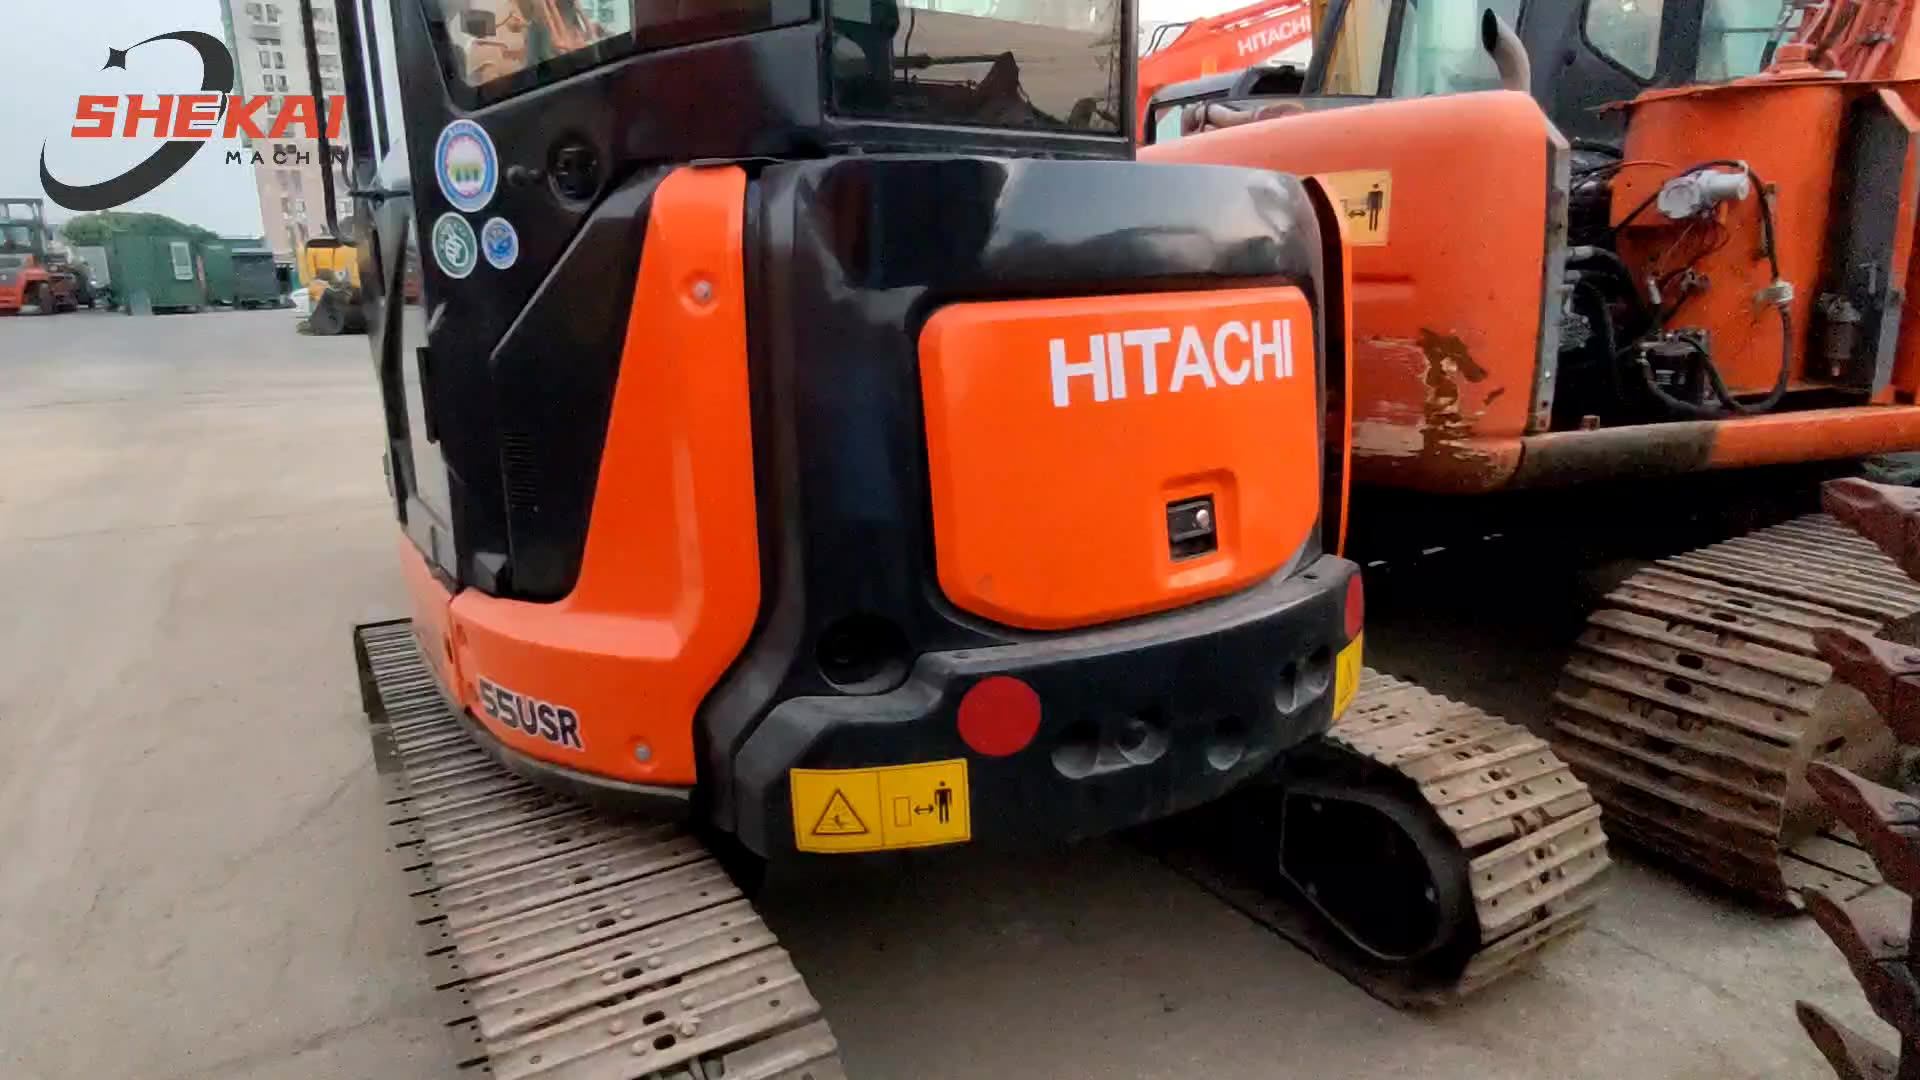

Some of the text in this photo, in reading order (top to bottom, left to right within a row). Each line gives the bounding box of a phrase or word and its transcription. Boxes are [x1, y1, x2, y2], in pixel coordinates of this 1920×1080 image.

[1238, 15, 1312, 56] HITACHI
[1049, 319, 1293, 408] HITACHI
[479, 677, 583, 749] 55USR
